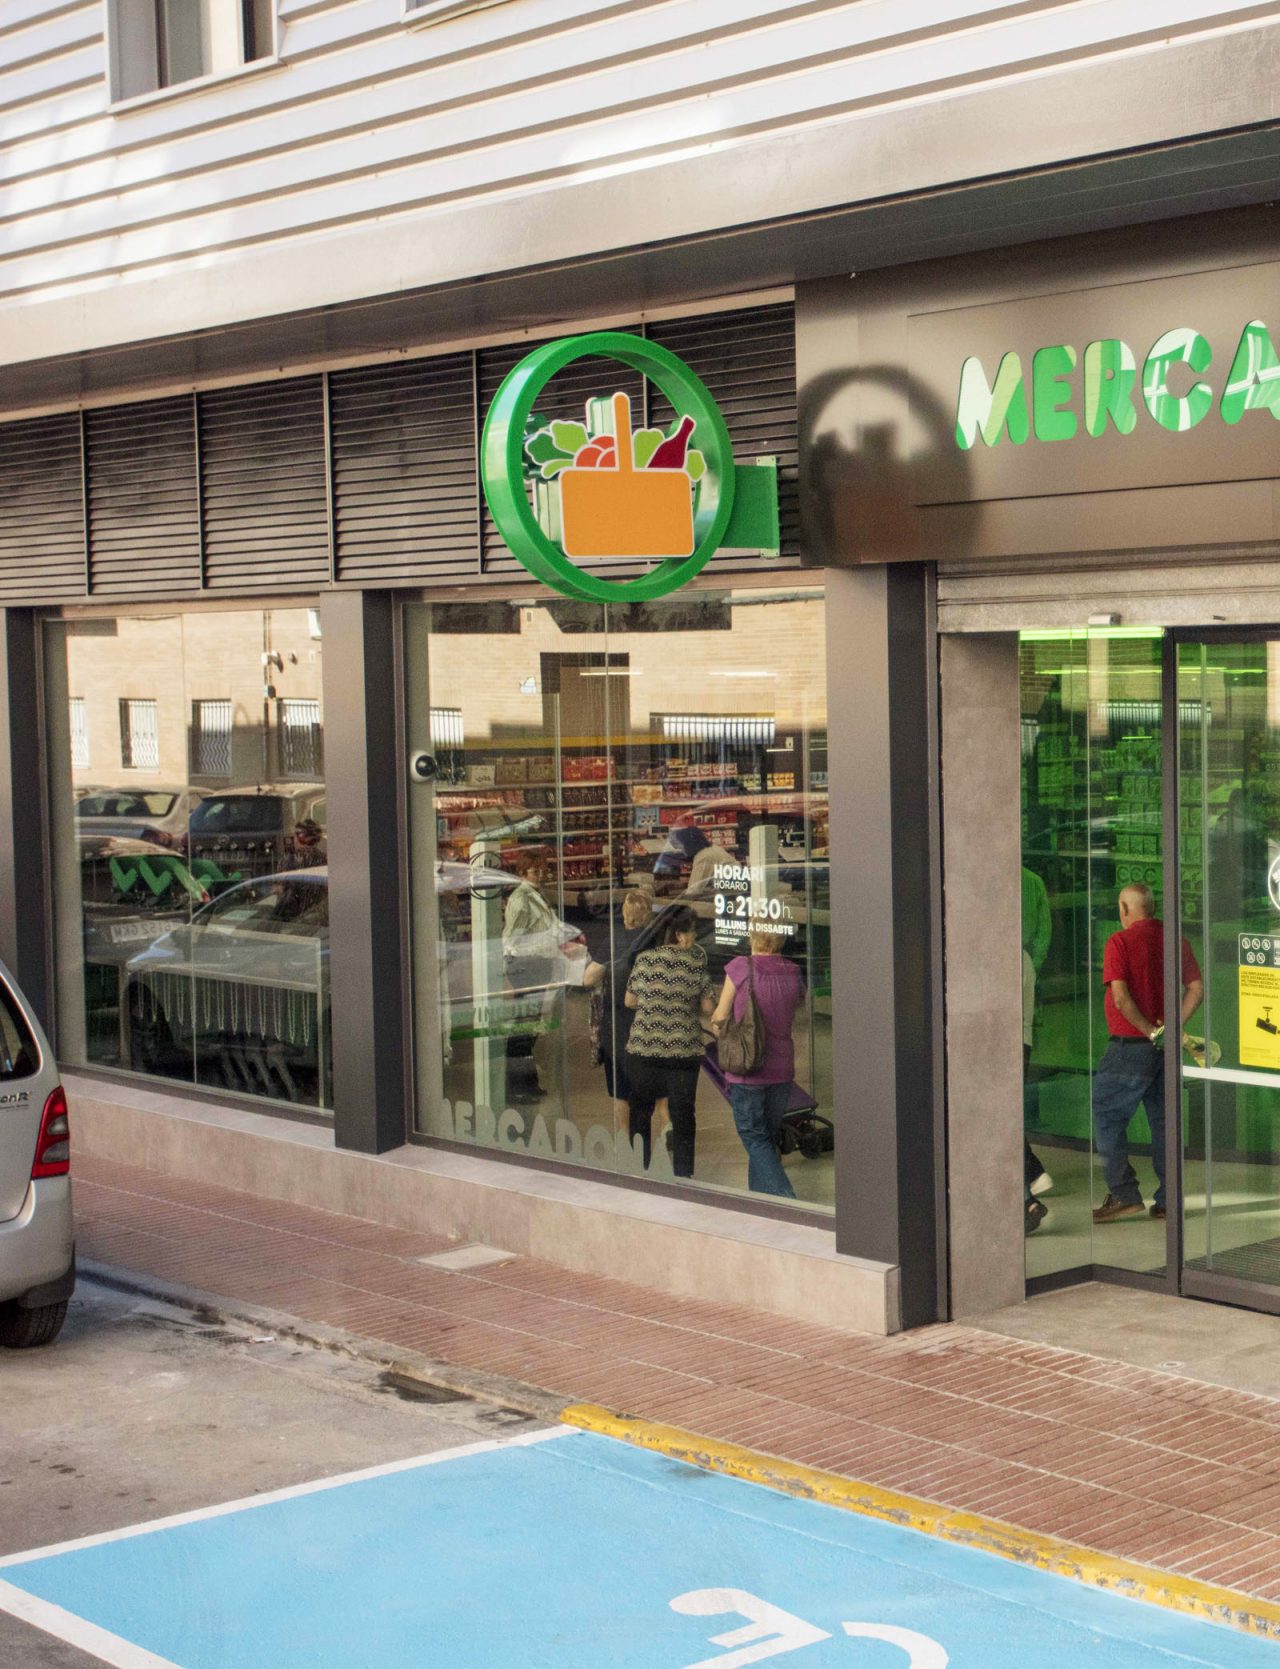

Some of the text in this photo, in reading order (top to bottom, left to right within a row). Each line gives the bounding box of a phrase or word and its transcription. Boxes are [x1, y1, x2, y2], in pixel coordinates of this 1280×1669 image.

[714, 864, 764, 882] HORARI
[714, 880, 748, 891] HORARIO
[714, 894, 725, 915] 9
[726, 901, 734, 913] a
[736, 895, 781, 919] 21:30
[715, 918, 747, 931] DILLUNS
[755, 923, 794, 935] DISSABTE
